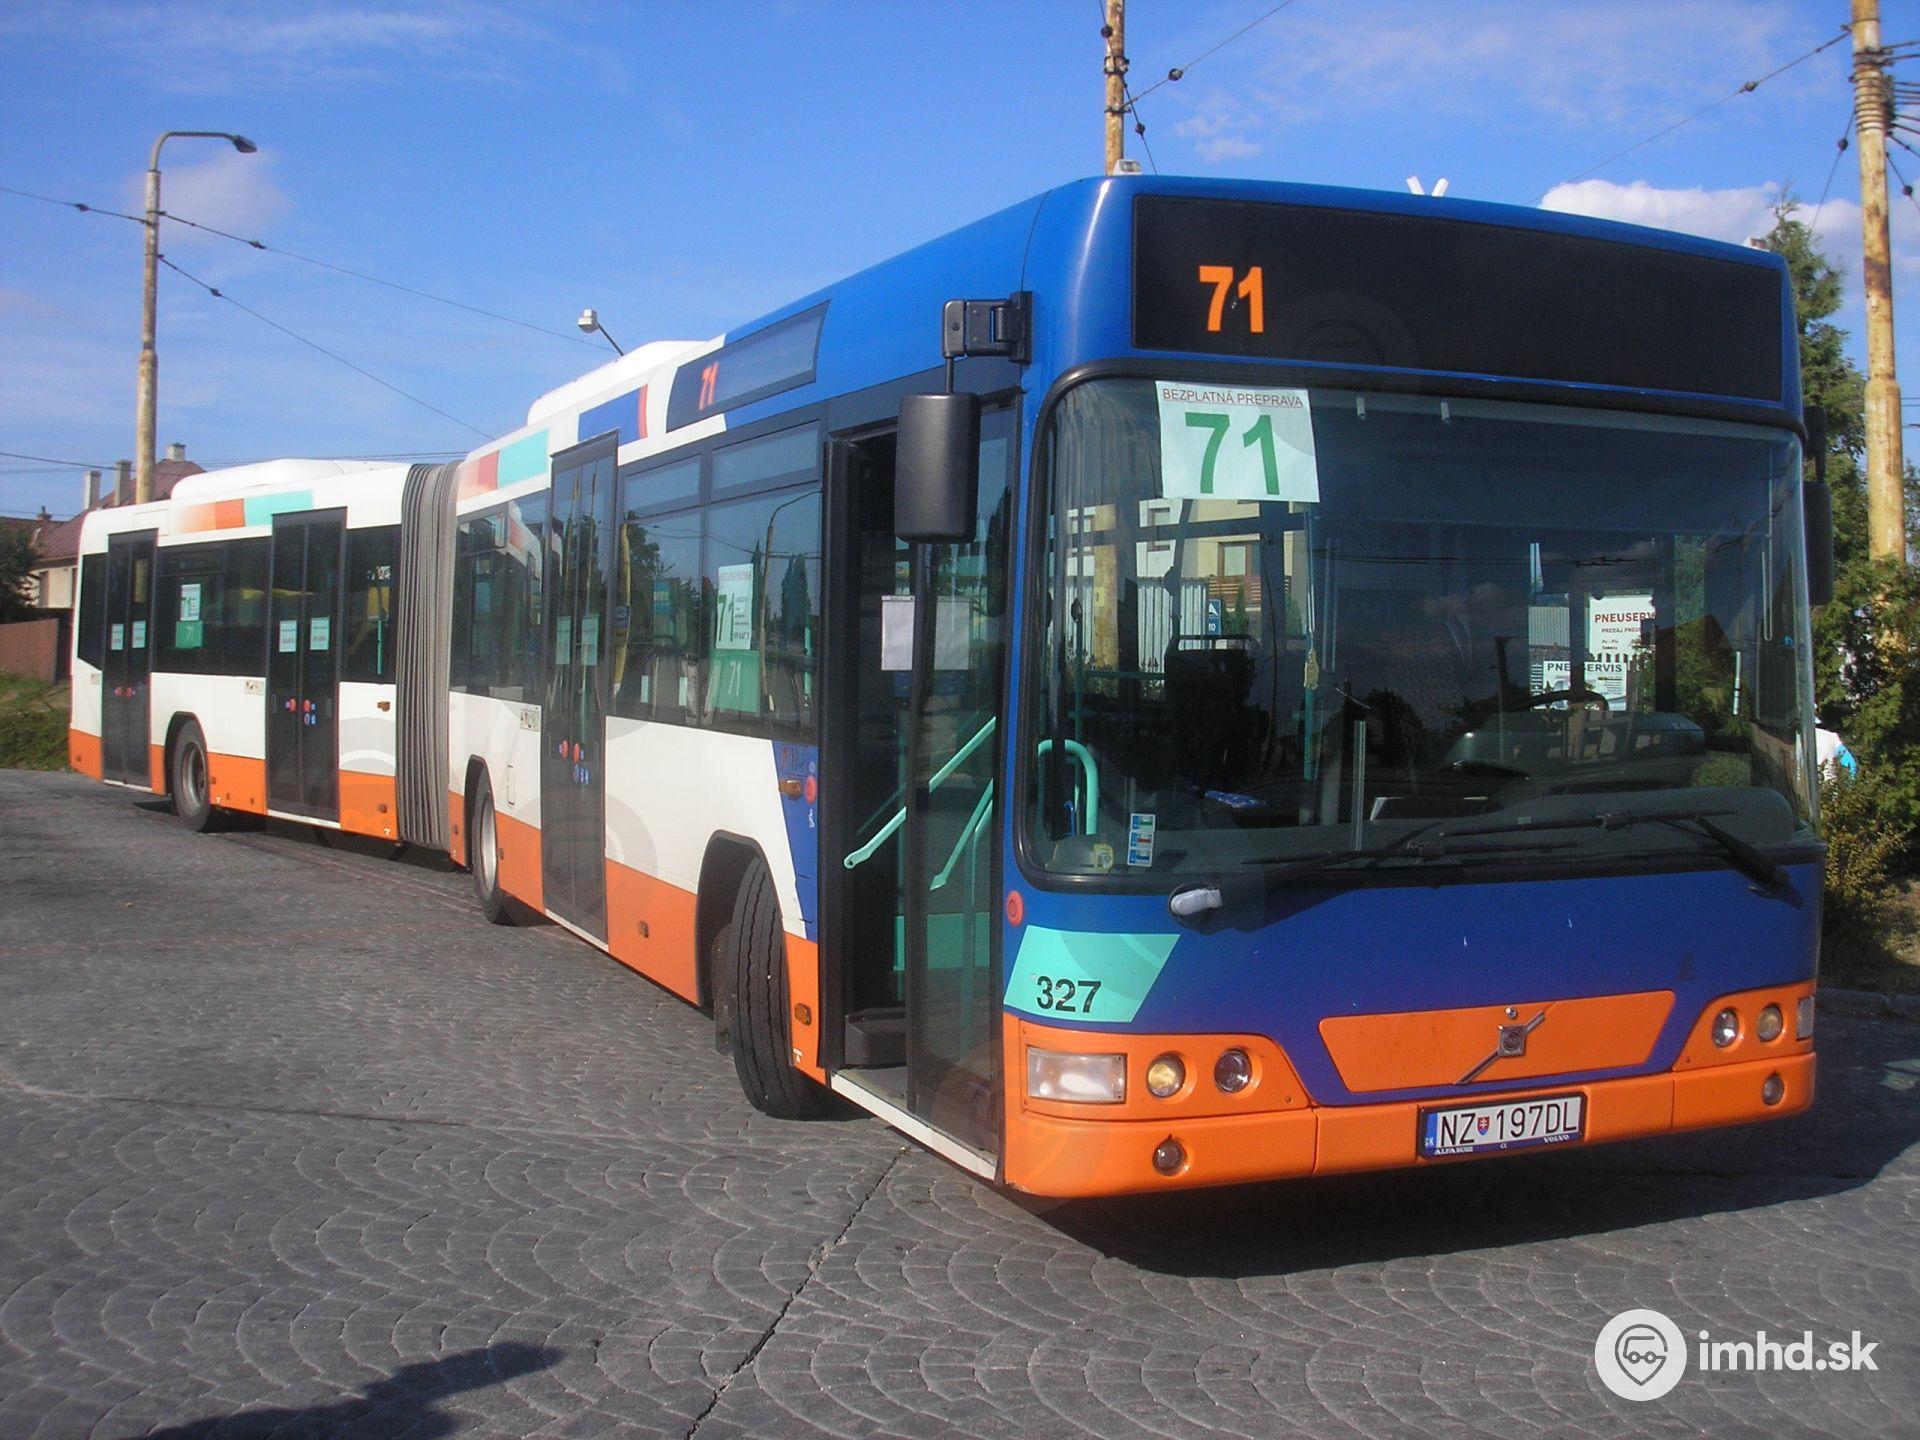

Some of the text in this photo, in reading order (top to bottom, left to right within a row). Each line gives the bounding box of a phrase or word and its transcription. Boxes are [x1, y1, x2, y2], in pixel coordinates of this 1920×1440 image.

[1198, 264, 1264, 333] 71
[1162, 387, 1304, 407] BEZPLATNÁ PREPRAVA
[1184, 411, 1280, 496] 71
[1036, 975, 1102, 1013] 327
[1440, 1101, 1577, 1147] NZ 197DL
[1543, 1133, 1570, 1144] VOLVO
